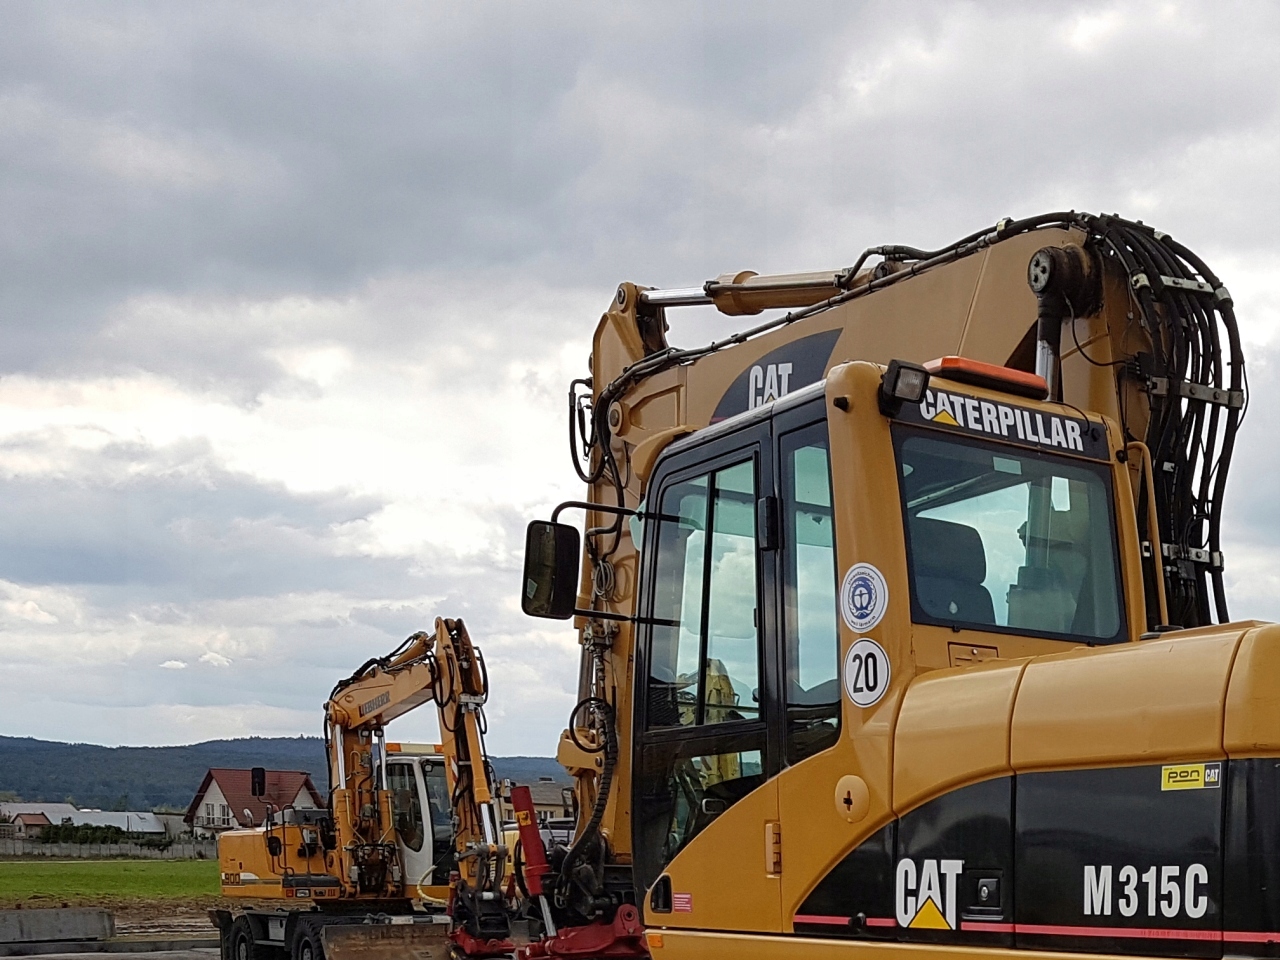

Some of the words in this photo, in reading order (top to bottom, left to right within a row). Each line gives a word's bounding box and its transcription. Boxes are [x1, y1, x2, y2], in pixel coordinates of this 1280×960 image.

[748, 362, 793, 411] CAT
[919, 389, 1084, 452] CATERPILLAR
[852, 651, 878, 694] 20
[1167, 769, 1200, 784] pon
[1205, 769, 1219, 783] CAT
[225, 873, 240, 884] 900
[895, 858, 963, 930] CAT
